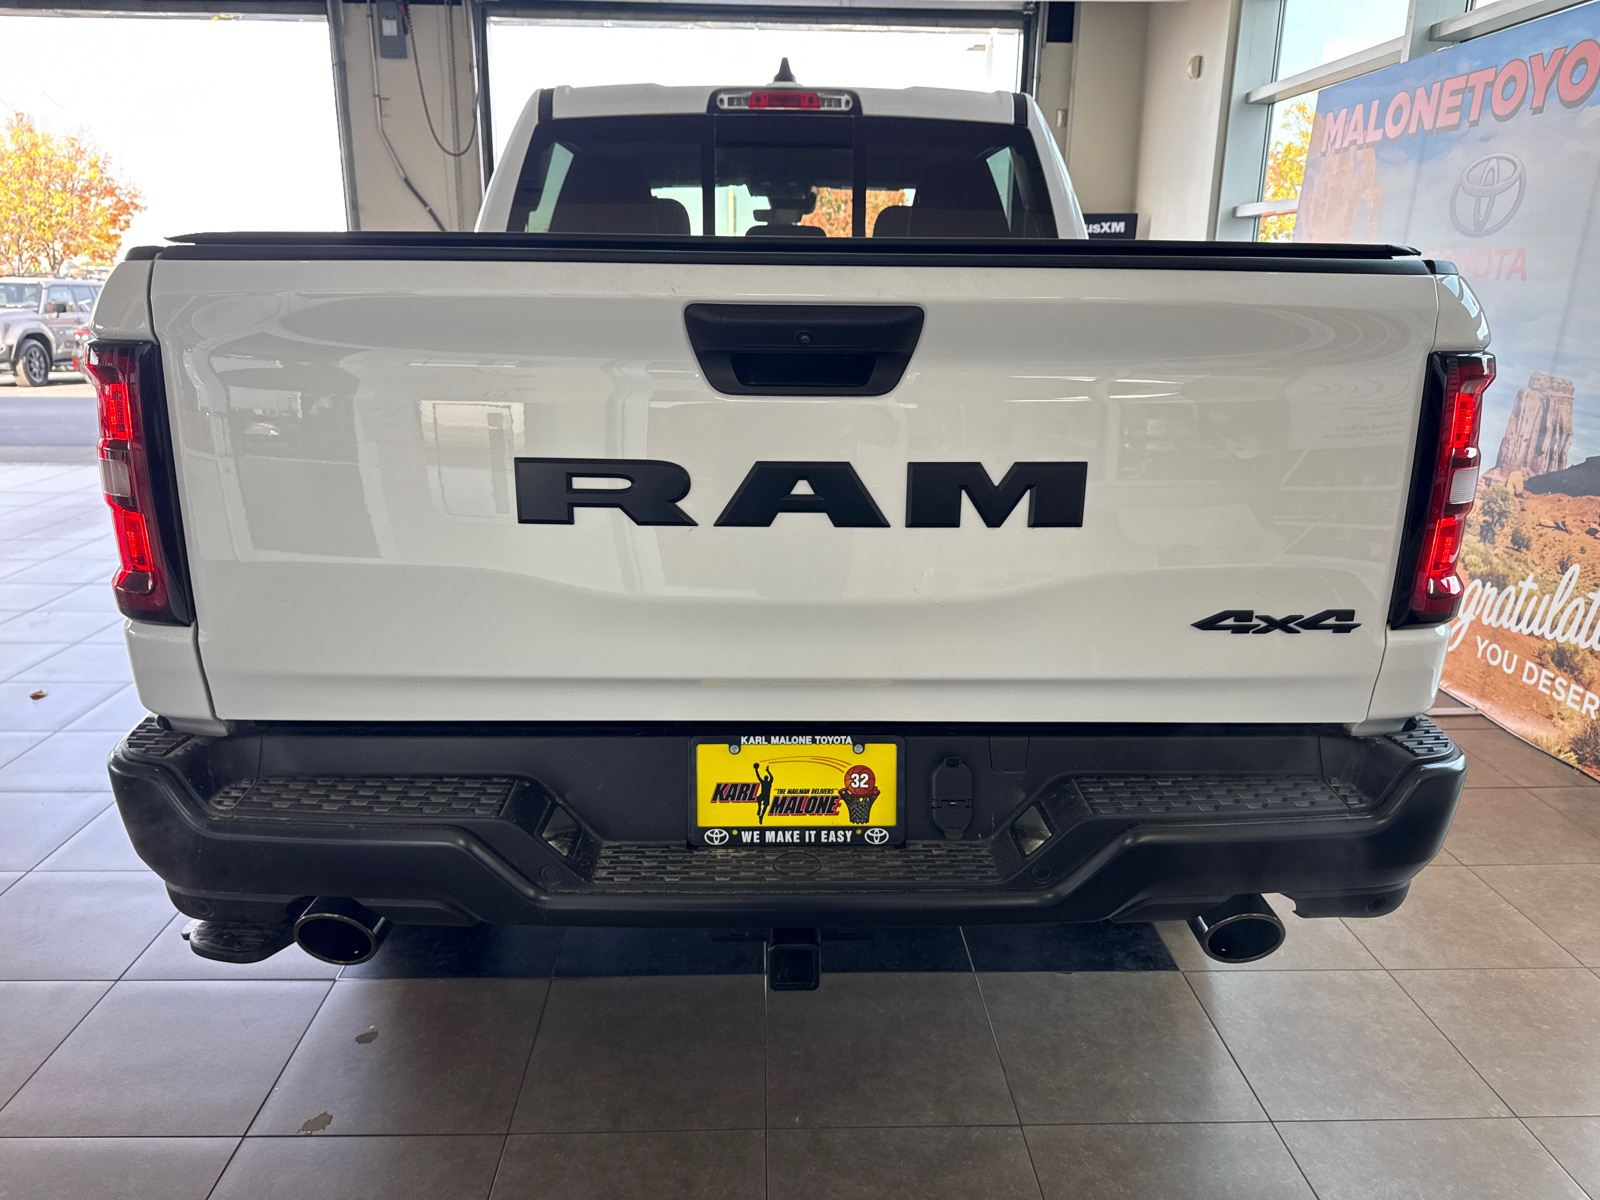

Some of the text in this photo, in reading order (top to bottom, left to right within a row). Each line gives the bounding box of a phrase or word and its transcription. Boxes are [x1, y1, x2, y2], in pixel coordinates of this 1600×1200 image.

[514, 457, 1088, 528] RAM
[1190, 609, 1361, 634] 4x4
[1476, 635, 1600, 720] YOU DESER
[740, 735, 853, 745] KARL MALONE TOYOTA
[850, 773, 869, 788] 32
[711, 782, 760, 803] KARL
[768, 795, 842, 816] MALONE
[741, 830, 853, 843] WE MAKE IT EASY
